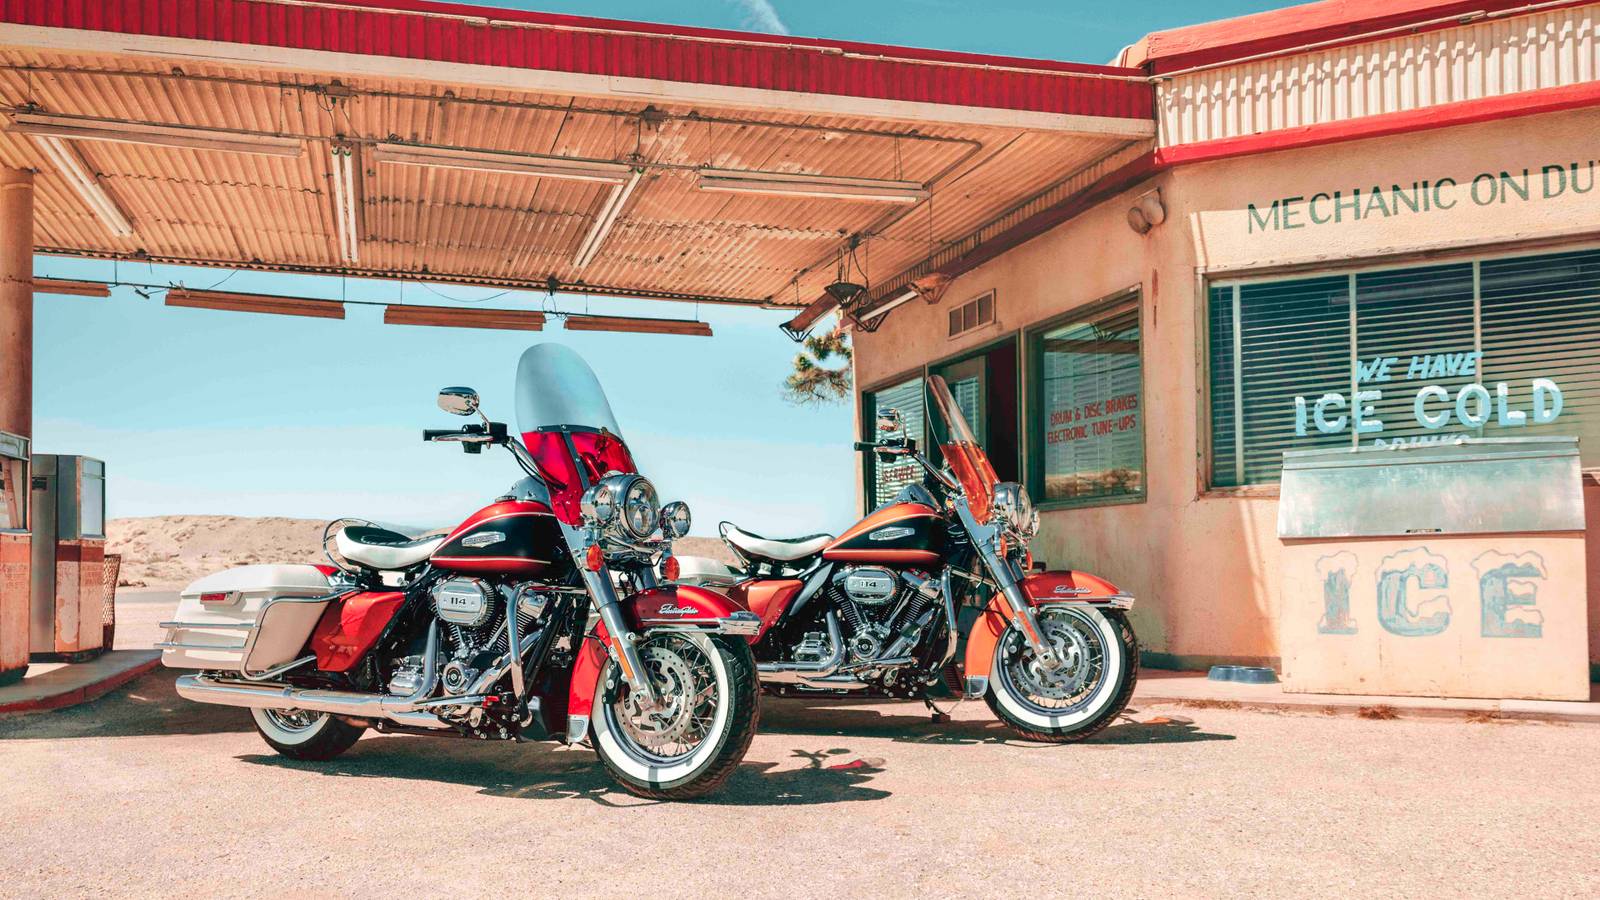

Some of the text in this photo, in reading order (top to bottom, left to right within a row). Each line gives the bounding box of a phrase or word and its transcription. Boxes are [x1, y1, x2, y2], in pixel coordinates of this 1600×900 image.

[1248, 160, 1600, 234] MECHANIC ON DU
[1355, 351, 1484, 383] WE HAVE
[1050, 394, 1137, 426] DRUM & DISC BRAKES
[1294, 378, 1563, 436] ICE COLD
[1047, 414, 1136, 444] ELECTRONIC TUNE-UPS
[451, 597, 466, 605] 114
[1315, 546, 1548, 638] ICE
